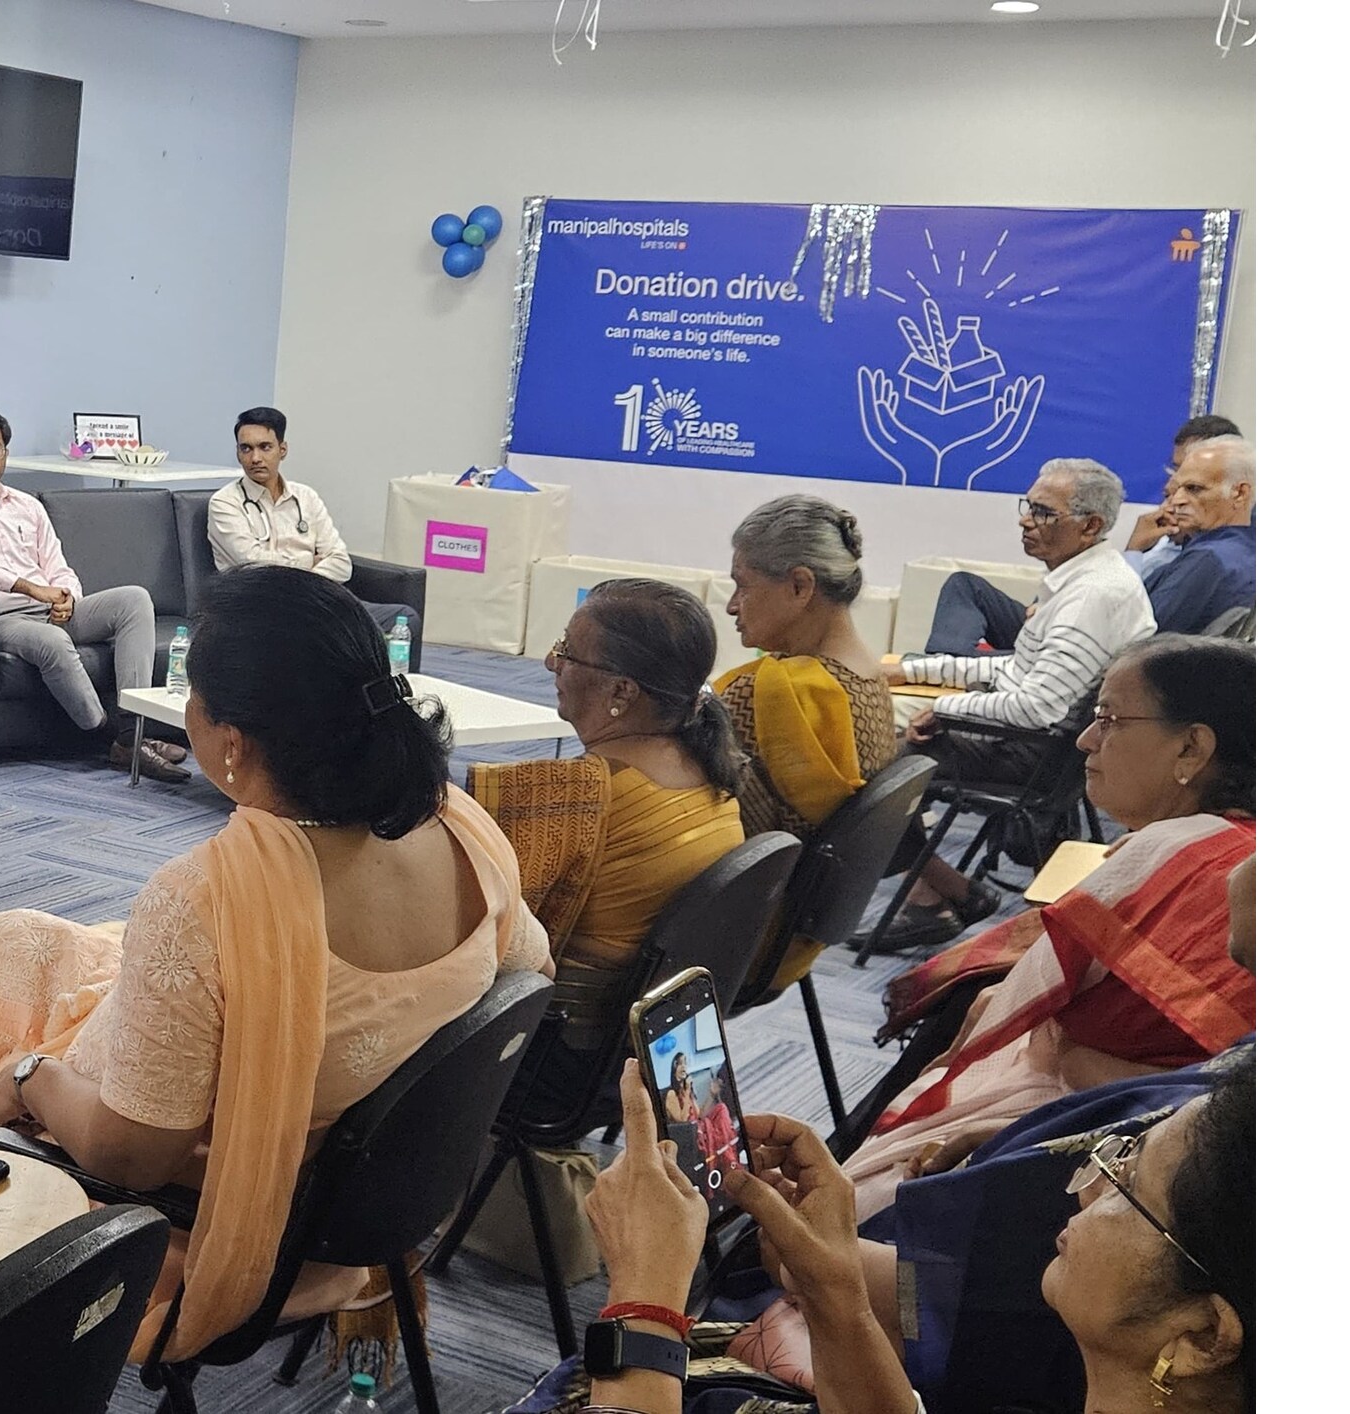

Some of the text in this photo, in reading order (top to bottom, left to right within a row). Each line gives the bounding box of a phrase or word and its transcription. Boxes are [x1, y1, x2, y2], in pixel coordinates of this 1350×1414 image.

[548, 217, 689, 239] manipalhospitals
[594, 268, 805, 302] Donation drive.
[626, 307, 764, 327] A small contribution
[605, 327, 781, 347] can make a big difference
[632, 343, 751, 363] in someone's life.
[673, 419, 740, 441] YEARS
[676, 444, 698, 453] WITH
[437, 540, 478, 553] CLOTHES
